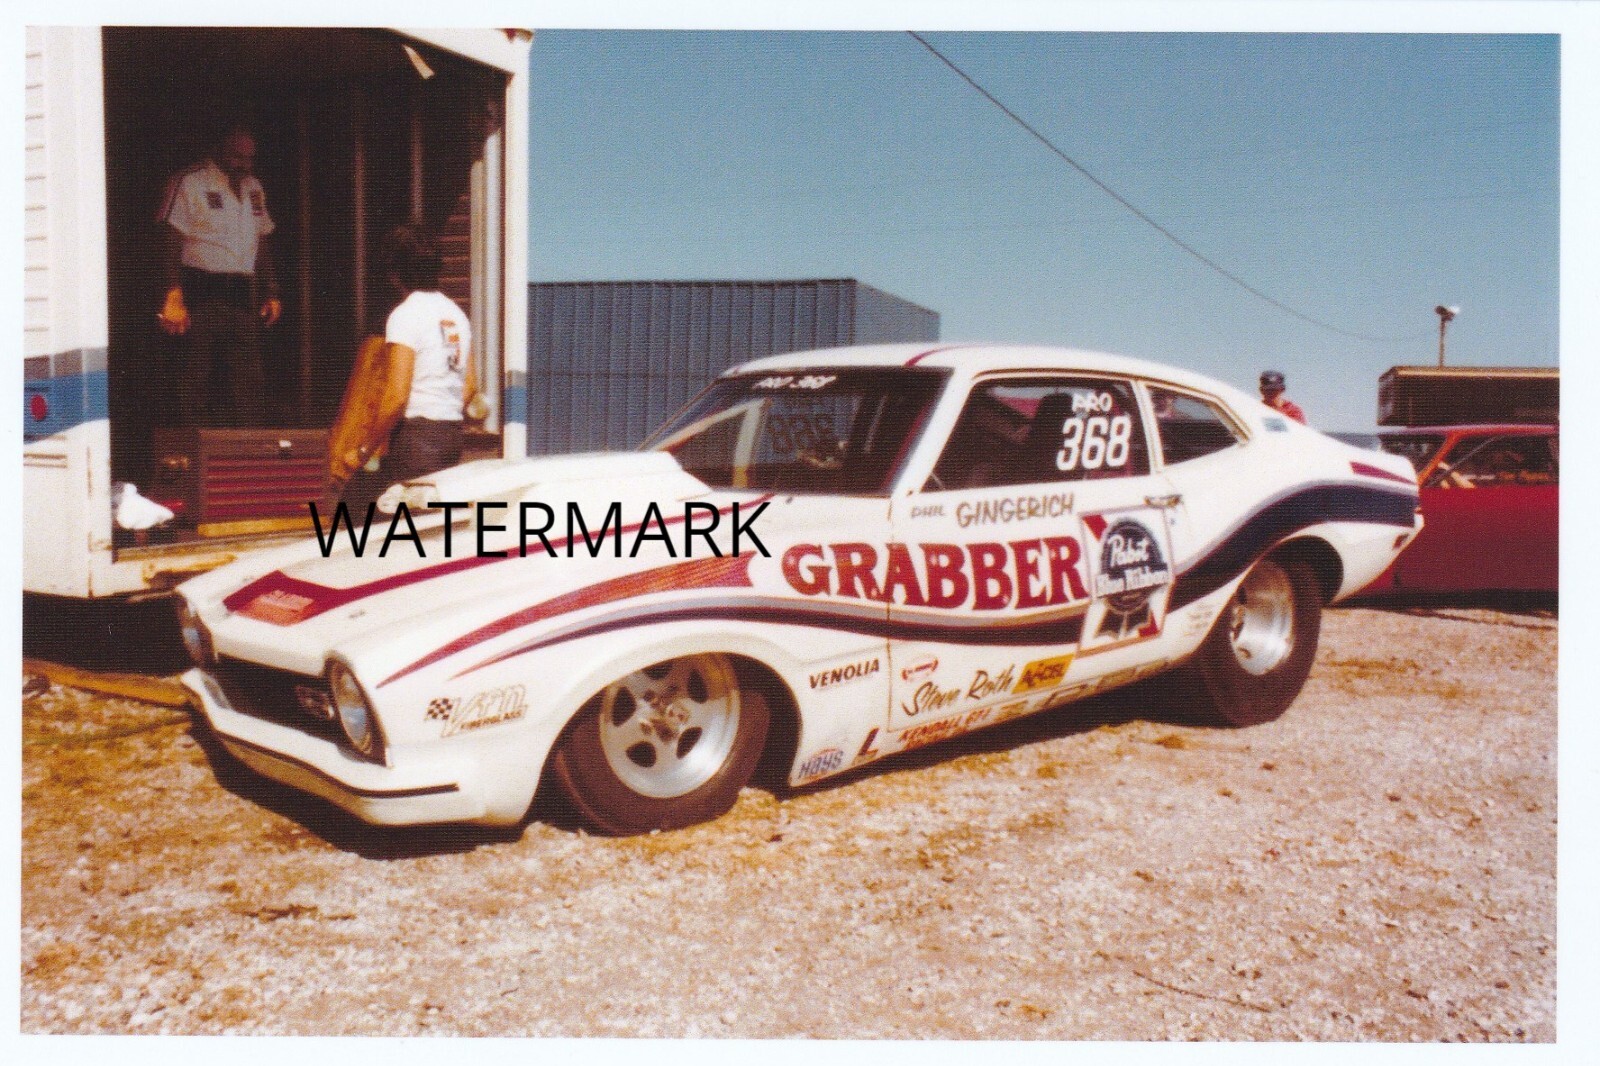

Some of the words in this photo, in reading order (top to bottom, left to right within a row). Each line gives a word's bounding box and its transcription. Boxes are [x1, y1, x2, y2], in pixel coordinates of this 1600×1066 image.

[1056, 415, 1131, 471] 368
[956, 493, 1074, 528] GINGERICH
[1107, 533, 1150, 568] Pabst
[781, 536, 1089, 611] GRABBER
[809, 658, 880, 689] VENOLIA
